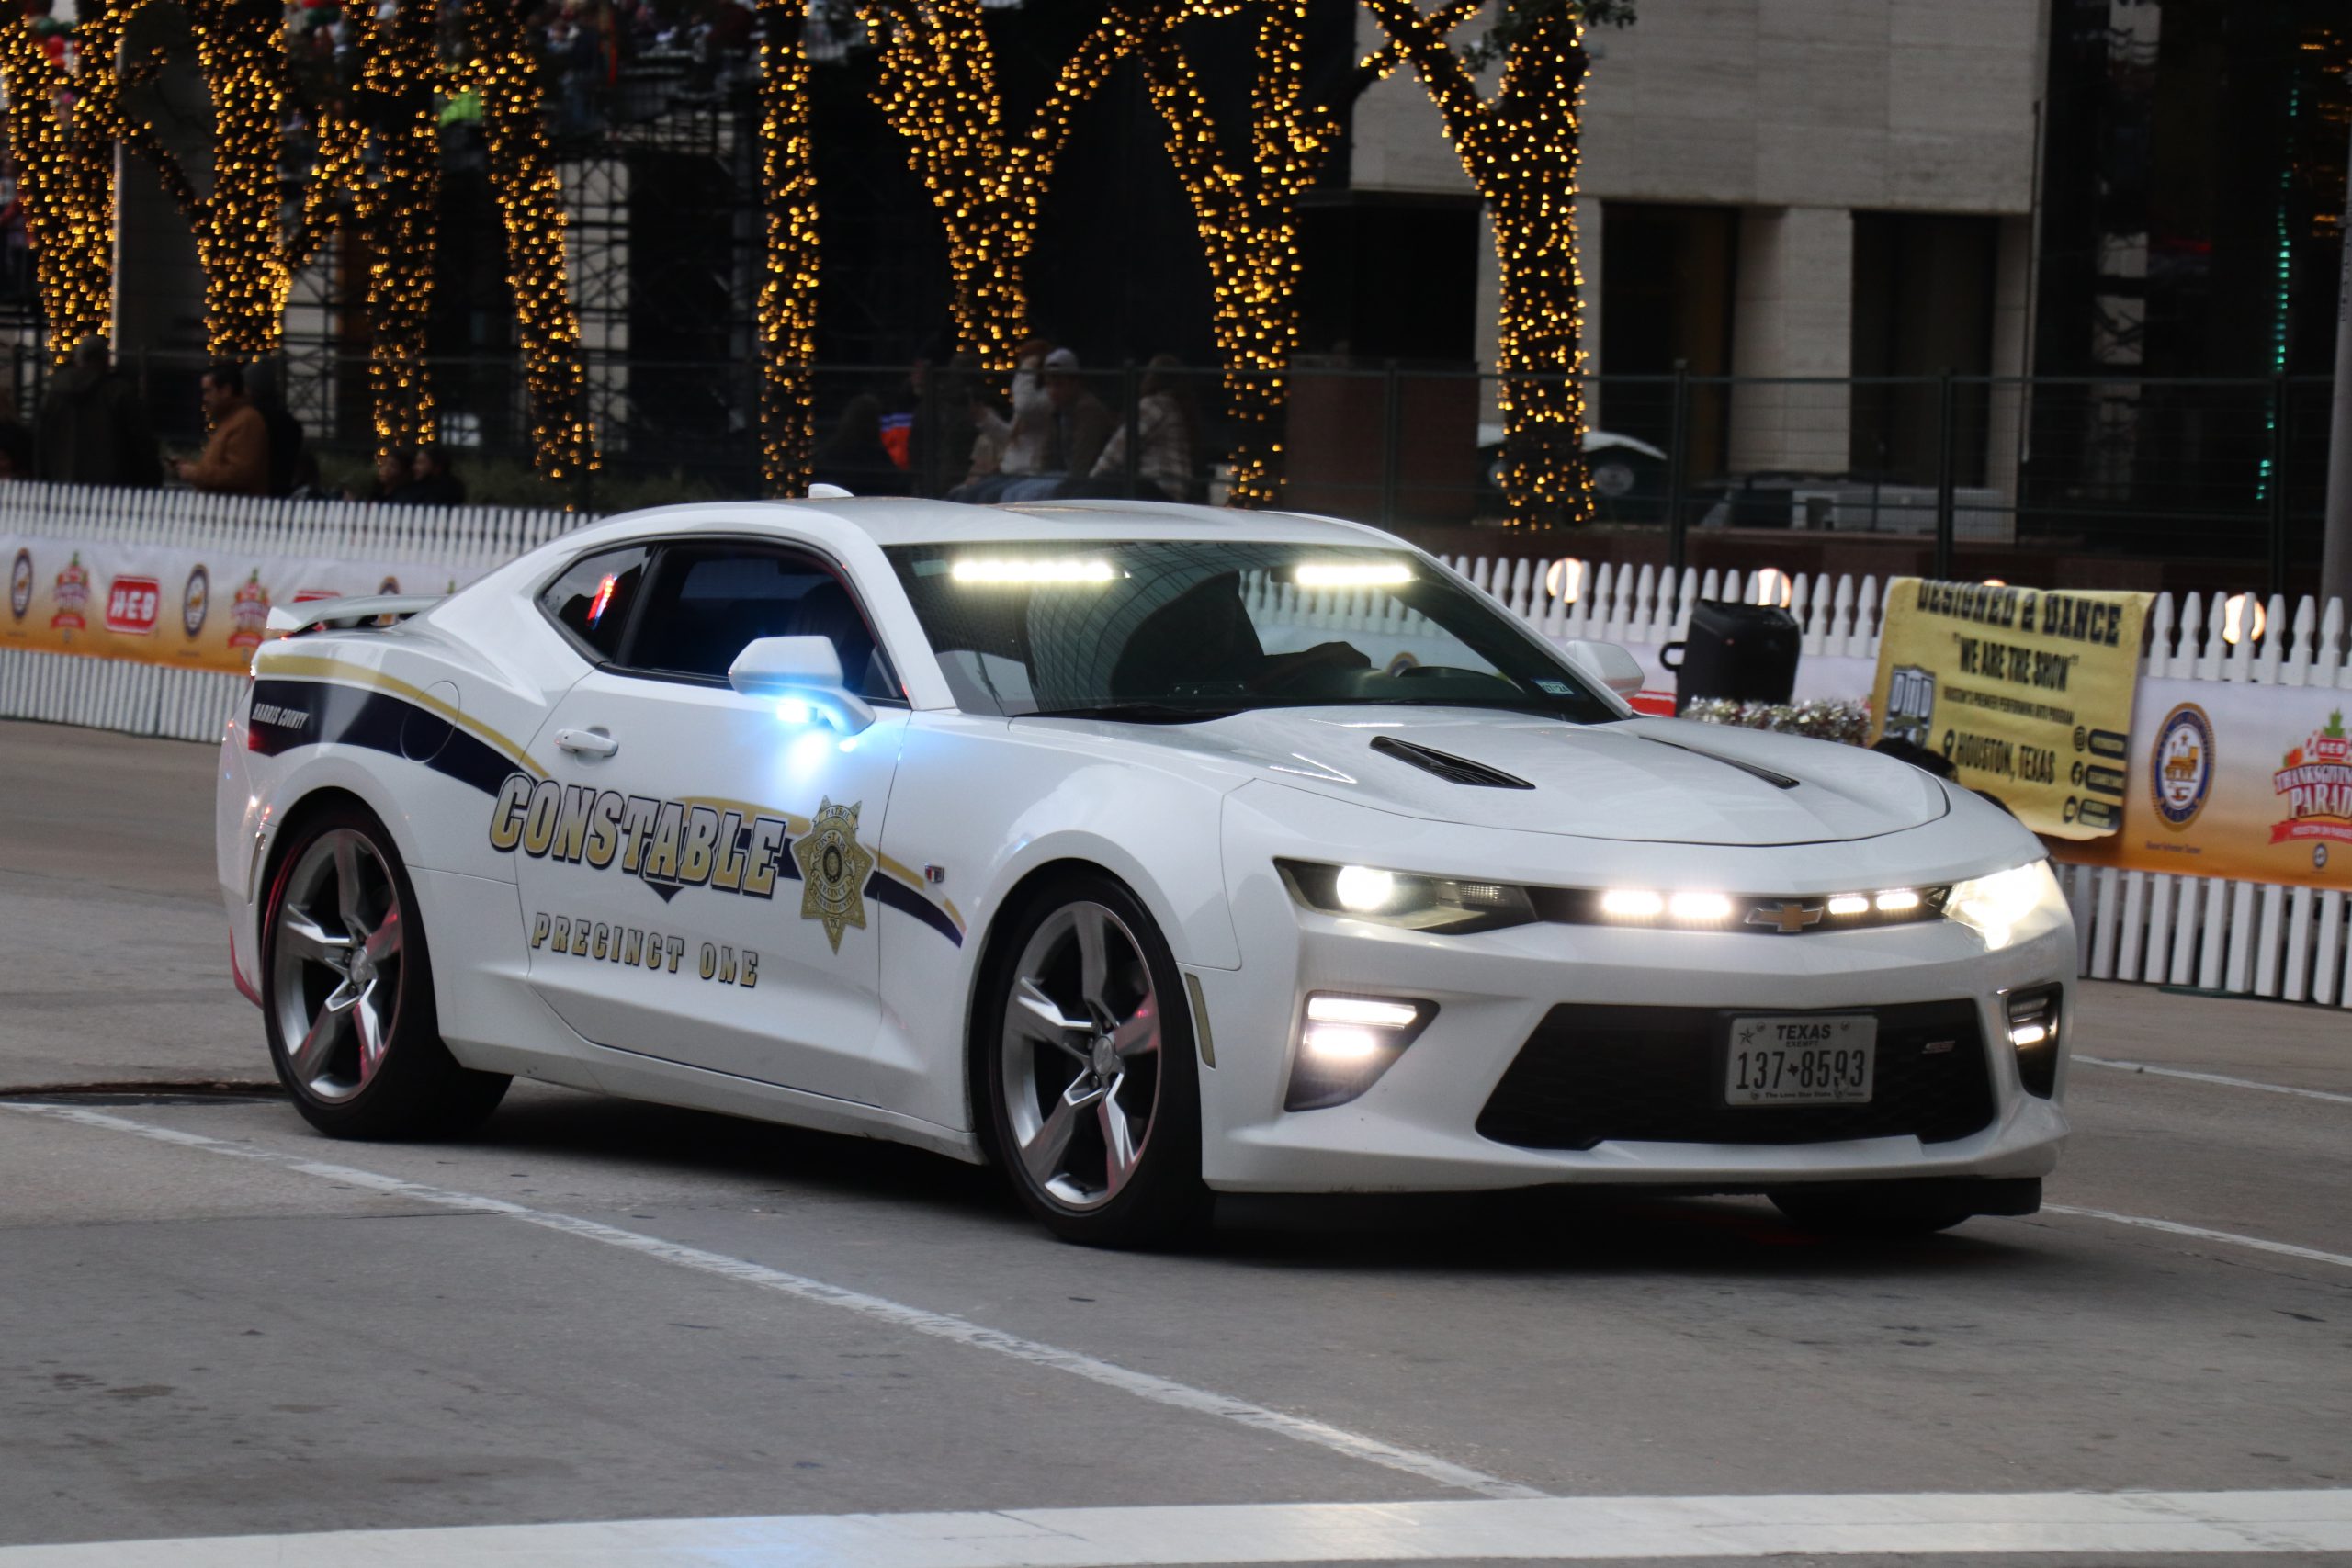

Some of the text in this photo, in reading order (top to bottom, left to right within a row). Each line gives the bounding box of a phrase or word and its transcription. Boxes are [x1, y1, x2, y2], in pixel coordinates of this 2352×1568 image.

[2042, 592, 2123, 648] DANCE
[1980, 641, 2006, 680] ARE
[2007, 645, 2031, 684] THE
[252, 703, 310, 729] HARRIS COUNTY
[1956, 732, 2055, 784] HOUSTON, TEXAS
[825, 807, 851, 822] PATROL
[2290, 784, 2352, 818] PARAD
[489, 772, 787, 900] CONSTABLE
[815, 877, 847, 897] PRECINCT
[531, 912, 760, 989] PRECINCT ONE
[1776, 1024, 1831, 1040] TEXAS
[1786, 1040, 1819, 1048] EXEMPT
